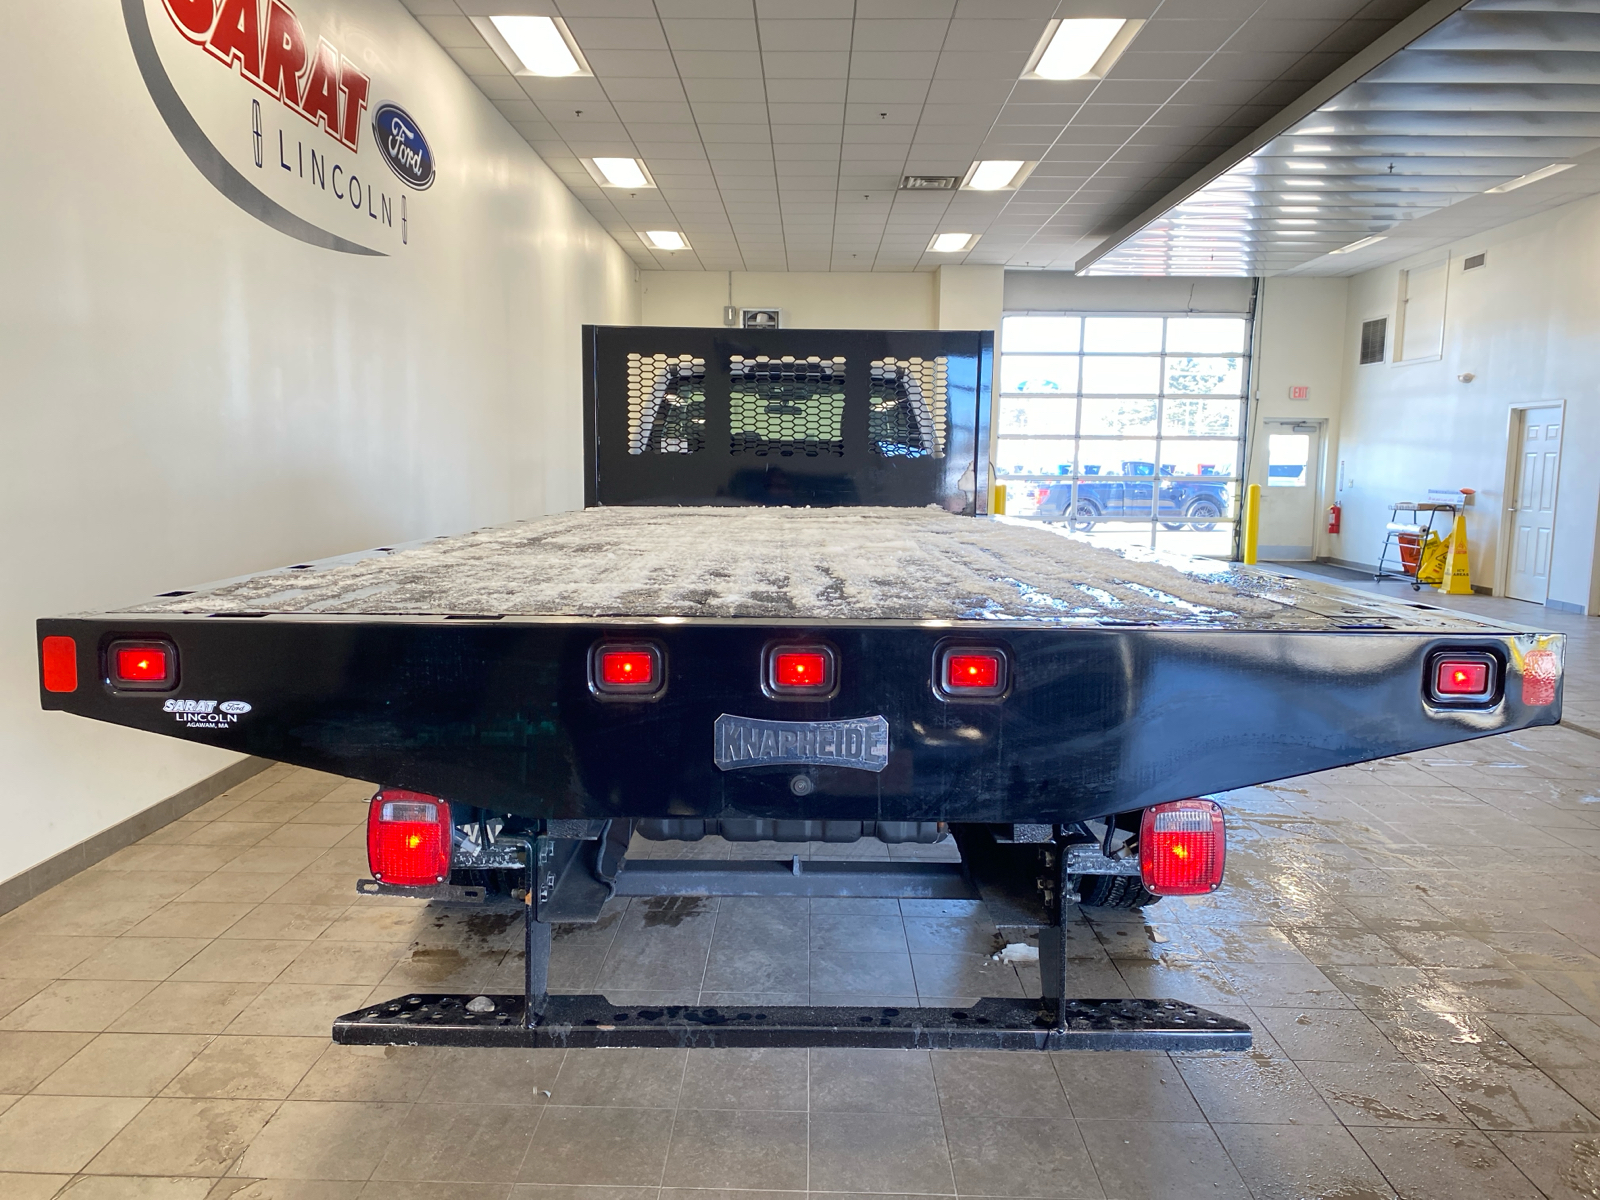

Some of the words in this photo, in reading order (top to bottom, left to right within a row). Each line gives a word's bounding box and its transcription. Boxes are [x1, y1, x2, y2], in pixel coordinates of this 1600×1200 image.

[388, 117, 422, 176] Ford
[278, 129, 392, 228] LINCOLN
[1293, 386, 1308, 398] EXIT
[163, 699, 217, 713] SARAT
[176, 713, 238, 722] LINCOLN
[722, 723, 880, 763] KNAPHEIDE
